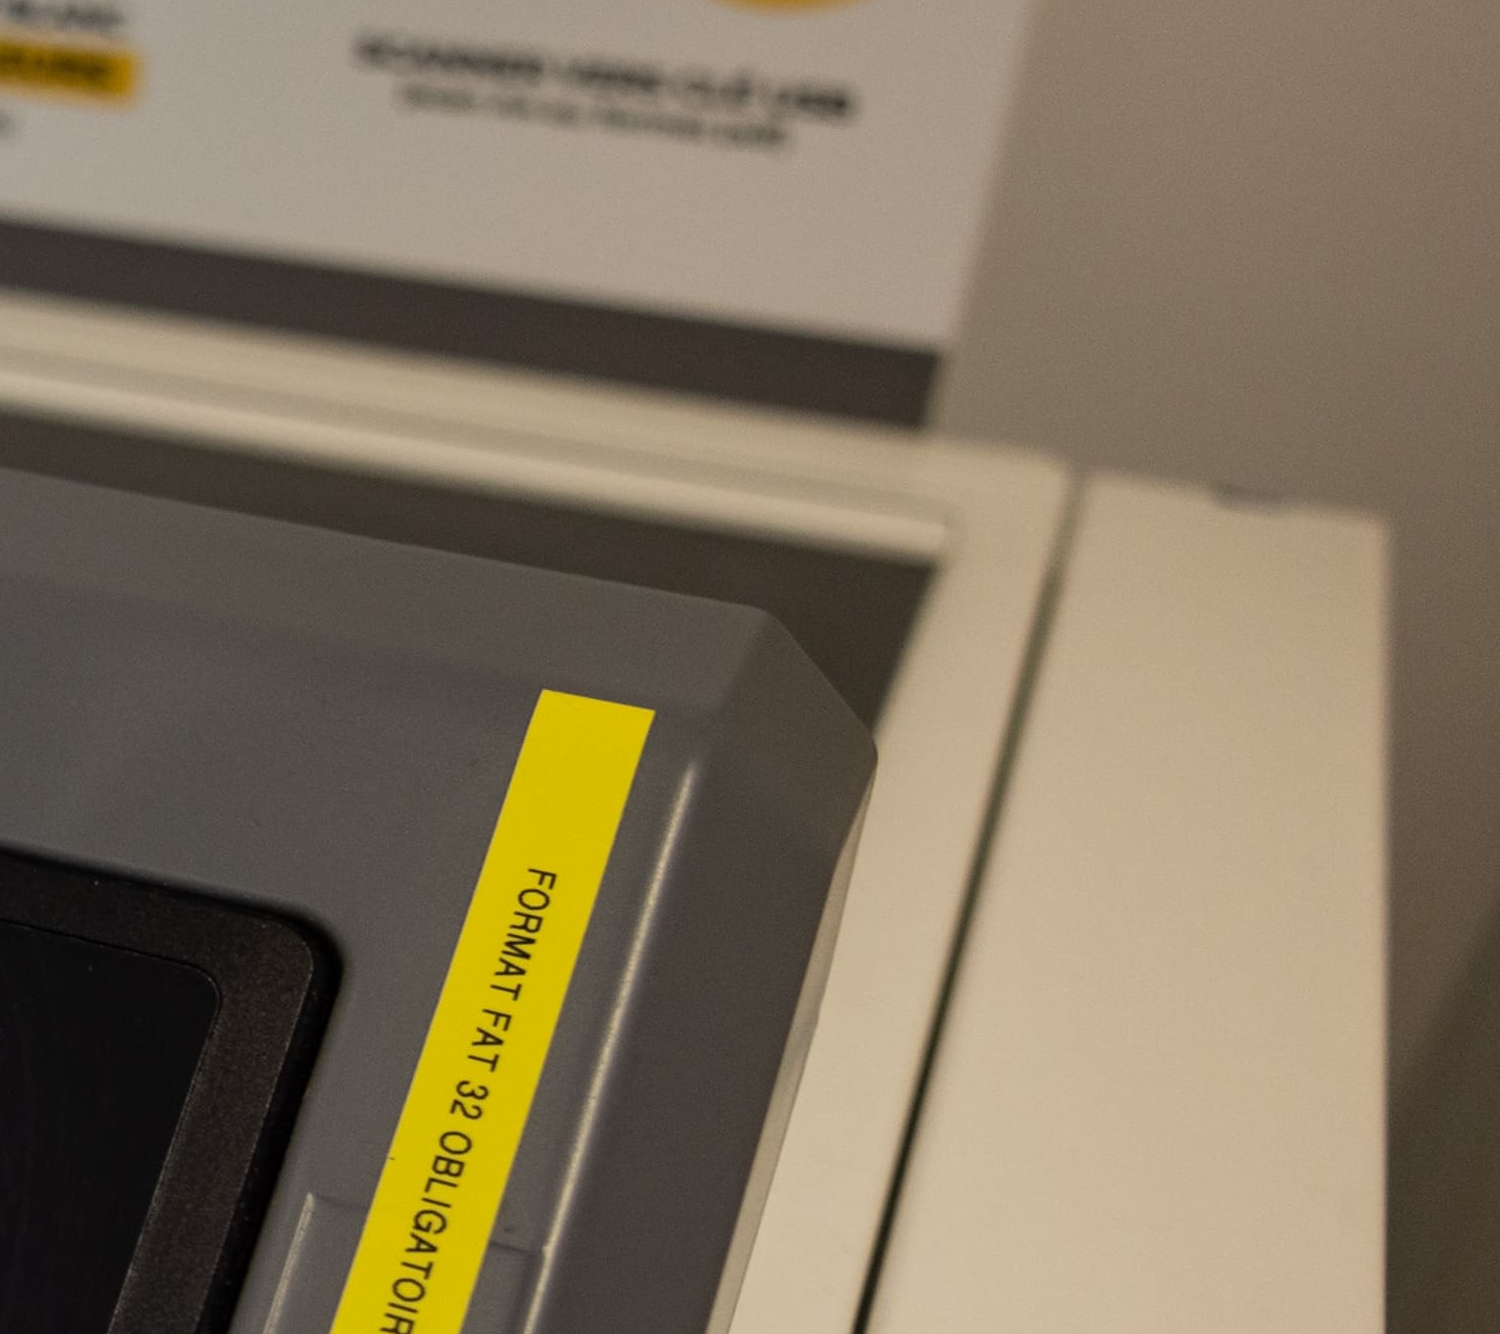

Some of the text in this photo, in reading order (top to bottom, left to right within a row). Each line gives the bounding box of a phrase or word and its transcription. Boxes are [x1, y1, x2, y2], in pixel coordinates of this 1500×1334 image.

[491, 867, 557, 1001] FORMAT
[466, 1007, 512, 1073] FAT
[449, 1078, 490, 1122] 32
